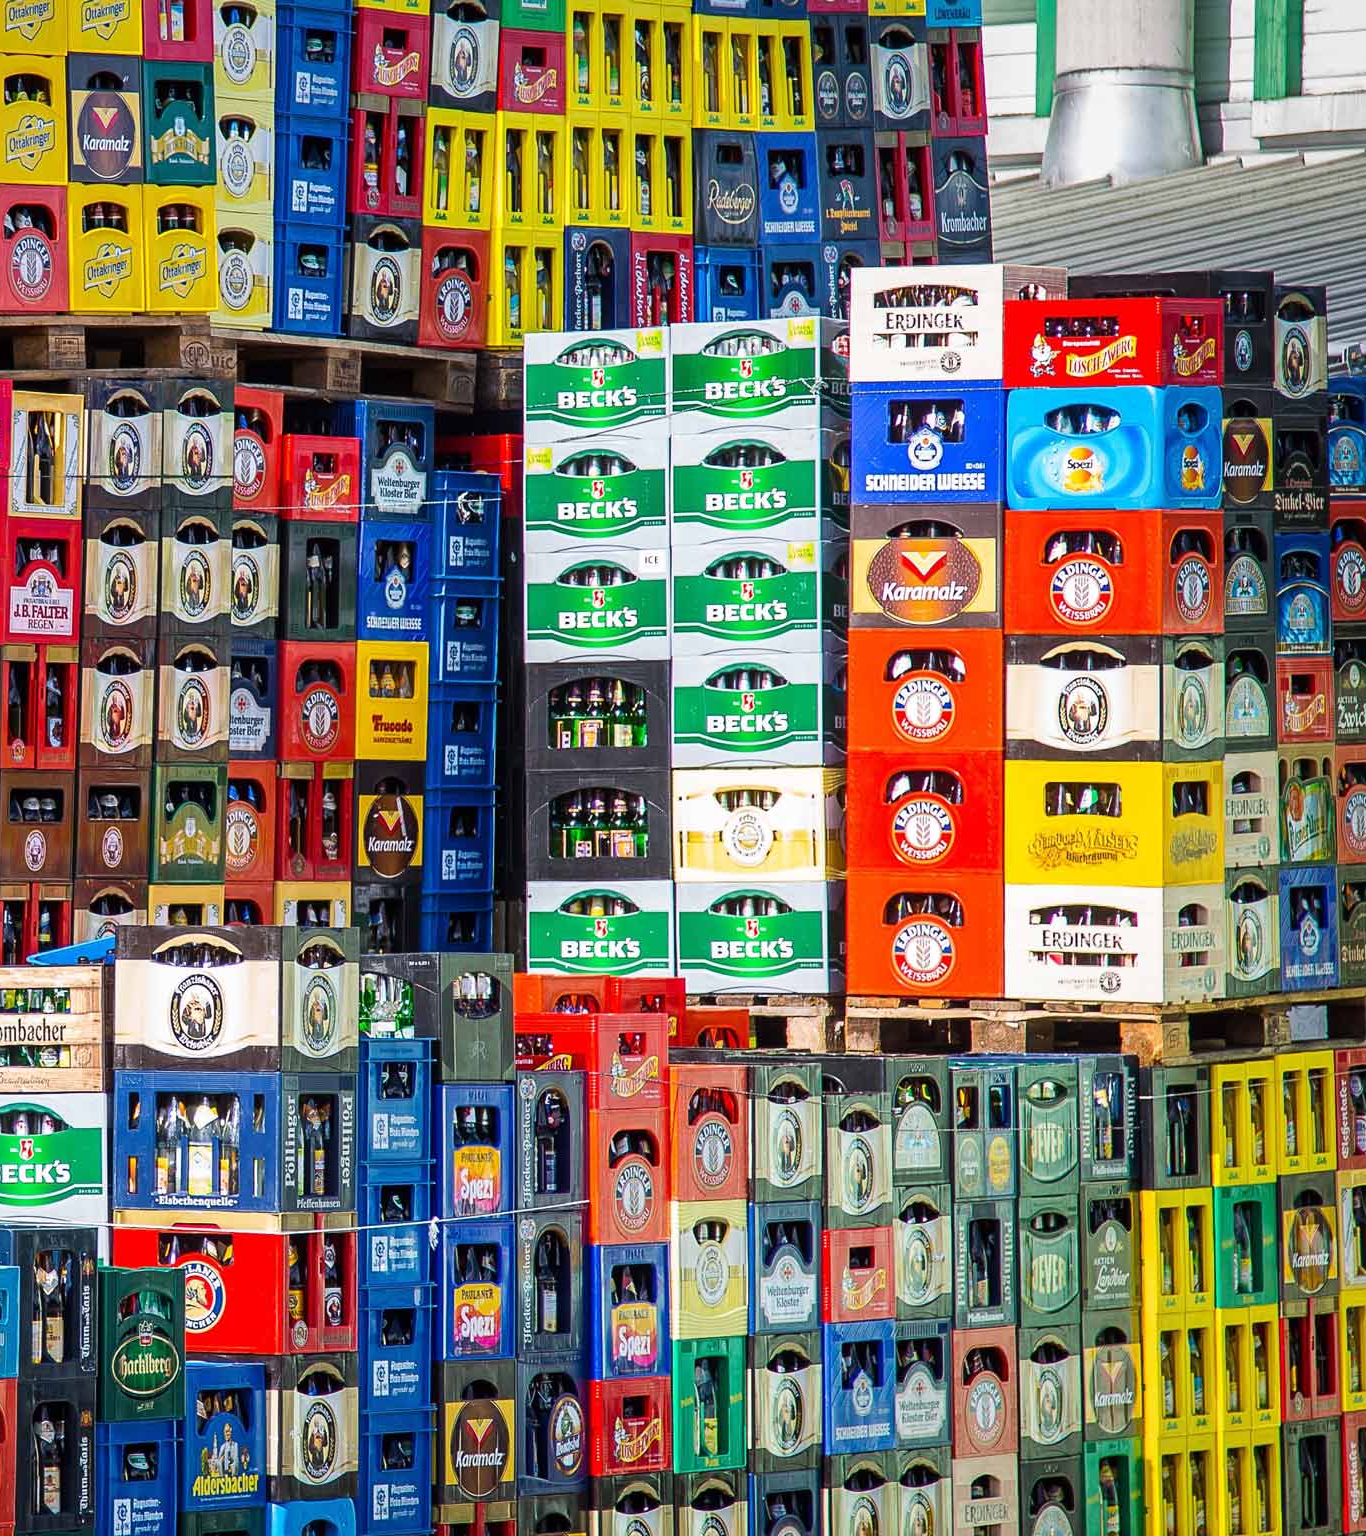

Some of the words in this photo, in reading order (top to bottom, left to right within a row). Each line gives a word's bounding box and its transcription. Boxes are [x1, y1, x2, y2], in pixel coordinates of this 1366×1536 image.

[9, 130, 52, 152] Ottakringer
[83, 134, 131, 152] Karamalz
[942, 210, 988, 236] Krombacher
[12, 234, 51, 266] ERDINGER
[885, 311, 964, 330] ERDINGER
[557, 385, 636, 410] BECK'S
[705, 376, 786, 399] BECK'S
[1067, 458, 1094, 471] Spezi
[1224, 462, 1266, 478] Karamalz
[377, 476, 421, 489] Weltenburger
[379, 487, 401, 499] Kloster
[404, 489, 418, 499] Bier
[866, 473, 936, 492] SCHNEIDER
[557, 496, 637, 520] BECK'S
[705, 487, 787, 511] BECK'S
[644, 556, 659, 565] ICE
[1054, 560, 1110, 590] ERDINGER
[882, 581, 967, 601] Karamalz
[13, 605, 31, 619] J.B.
[32, 605, 69, 620] FALTER
[558, 606, 638, 629] BECK'S
[706, 600, 788, 622] BECK'S
[27, 619, 55, 630] REGEN
[303, 689, 337, 716] ERDINGER
[896, 678, 951, 706] ERDINGER
[706, 710, 788, 732] BECK'S
[895, 801, 950, 830] ERDINGER
[1226, 799, 1270, 817] ERDINGER
[368, 836, 413, 852] Karamalz
[560, 935, 641, 959] BECK'S
[711, 937, 794, 959] BECK'S
[895, 924, 950, 953] ERDINGER
[1042, 930, 1123, 950] ERDINGER
[1171, 931, 1215, 950] ERDINGER
[285, 1095, 297, 1187] Pöllinger
[341, 1095, 353, 1188] Pöllinger
[460, 1172, 494, 1201] Spezi
[1293, 1252, 1330, 1267] Karamalz
[461, 1287, 494, 1301] PAULANER
[766, 1284, 810, 1297] Weltenburger
[460, 1309, 496, 1340] Spezi
[619, 1328, 651, 1357] Spezi
[1095, 1391, 1133, 1408] Karamalz
[456, 1449, 504, 1468] Karamalz
[193, 1471, 260, 1498] Aldersbacher
